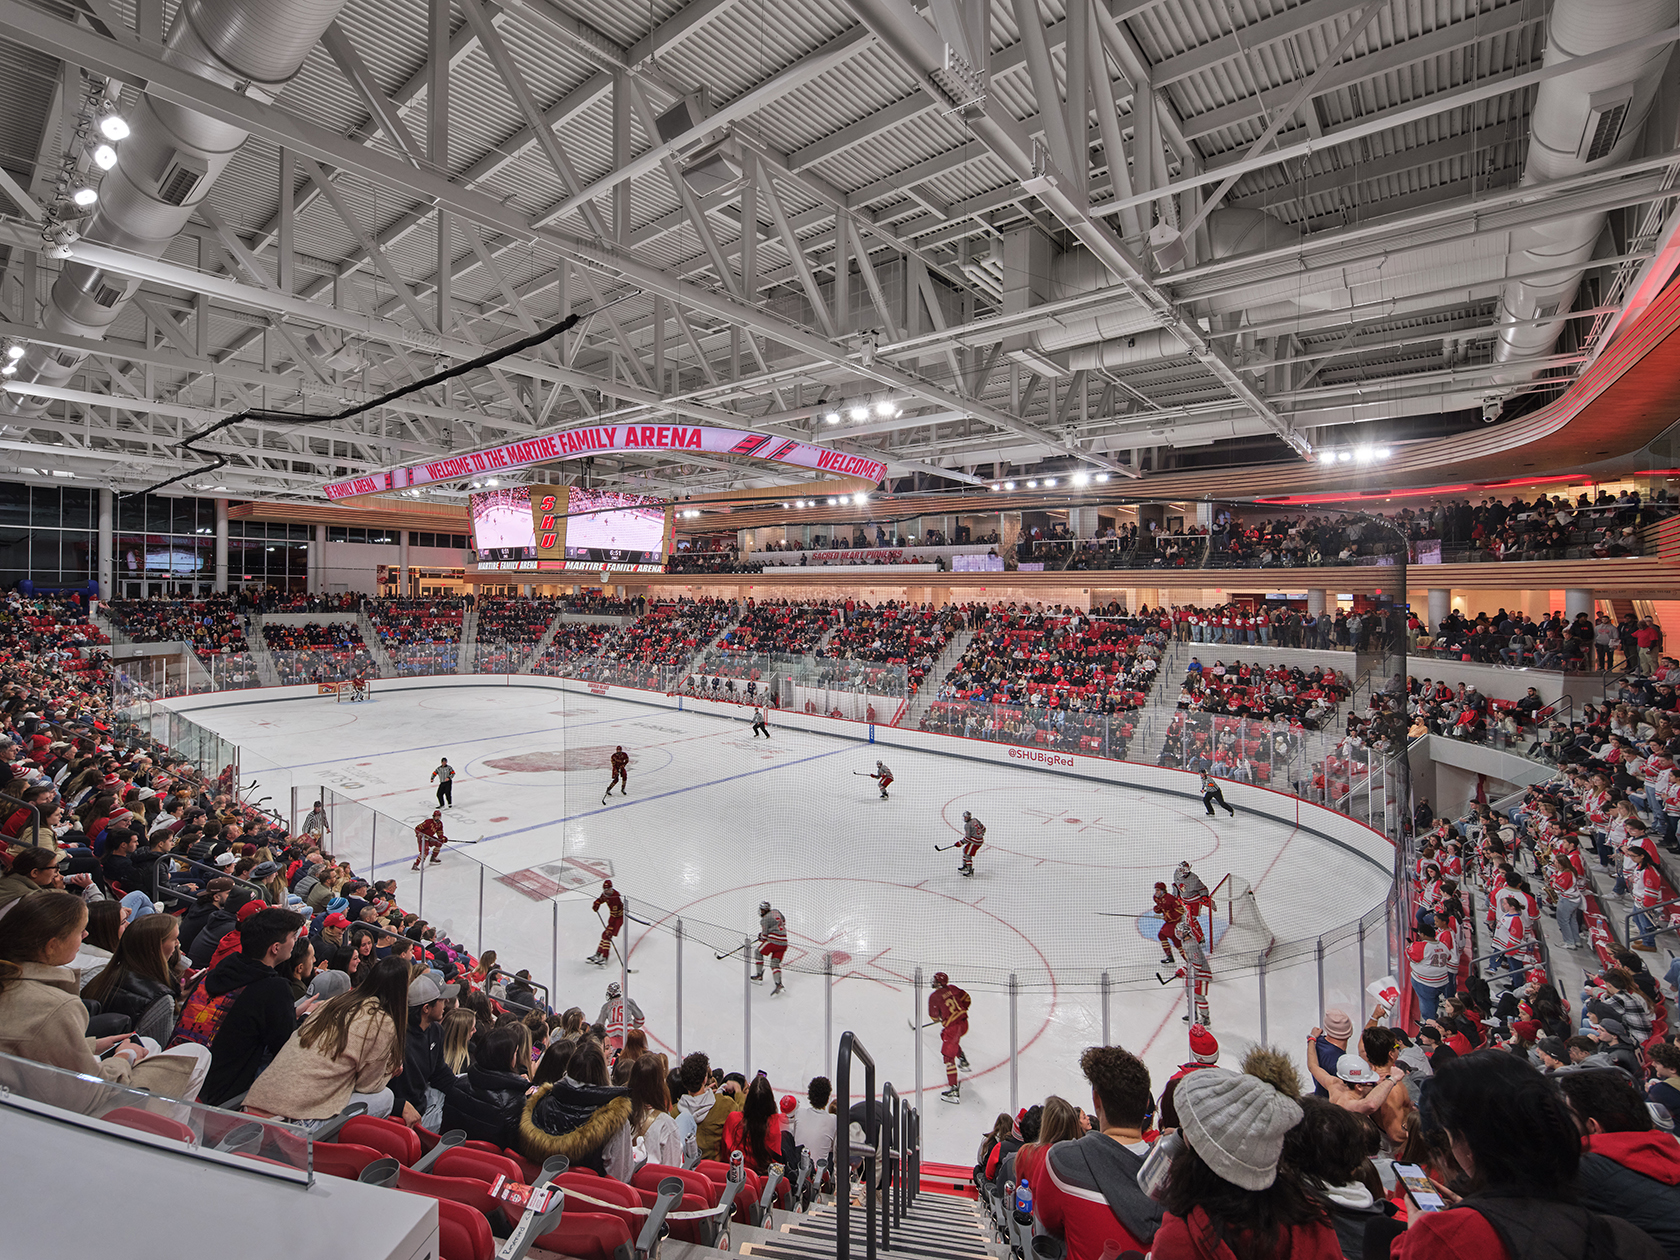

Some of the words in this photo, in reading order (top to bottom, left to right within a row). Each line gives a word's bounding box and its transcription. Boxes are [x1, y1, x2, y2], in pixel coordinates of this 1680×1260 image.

[425, 457, 472, 480] WELCOME
[470, 452, 485, 471] TO
[484, 446, 508, 468] THE
[506, 436, 560, 464] MARTIRE
[558, 427, 617, 454] FAMILY
[625, 427, 702, 448] ARENA
[816, 450, 878, 479] WELCOME
[332, 481, 354, 498] FAMILY
[353, 477, 378, 495] ARENA
[540, 495, 557, 549] SHU
[812, 552, 839, 560] SACRED
[841, 551, 864, 559] HEART
[478, 562, 500, 570] MARTIRE
[500, 561, 519, 570] FAMILY
[519, 561, 538, 569] ARENA
[564, 561, 605, 570] MARTIRE
[605, 563, 636, 572] FAMILY
[636, 564, 662, 573] ARENA
[1008, 748, 1074, 767] @SHUBigRed
[612, 1005, 624, 1023] 16
[184, 1136, 199, 1151] 14
